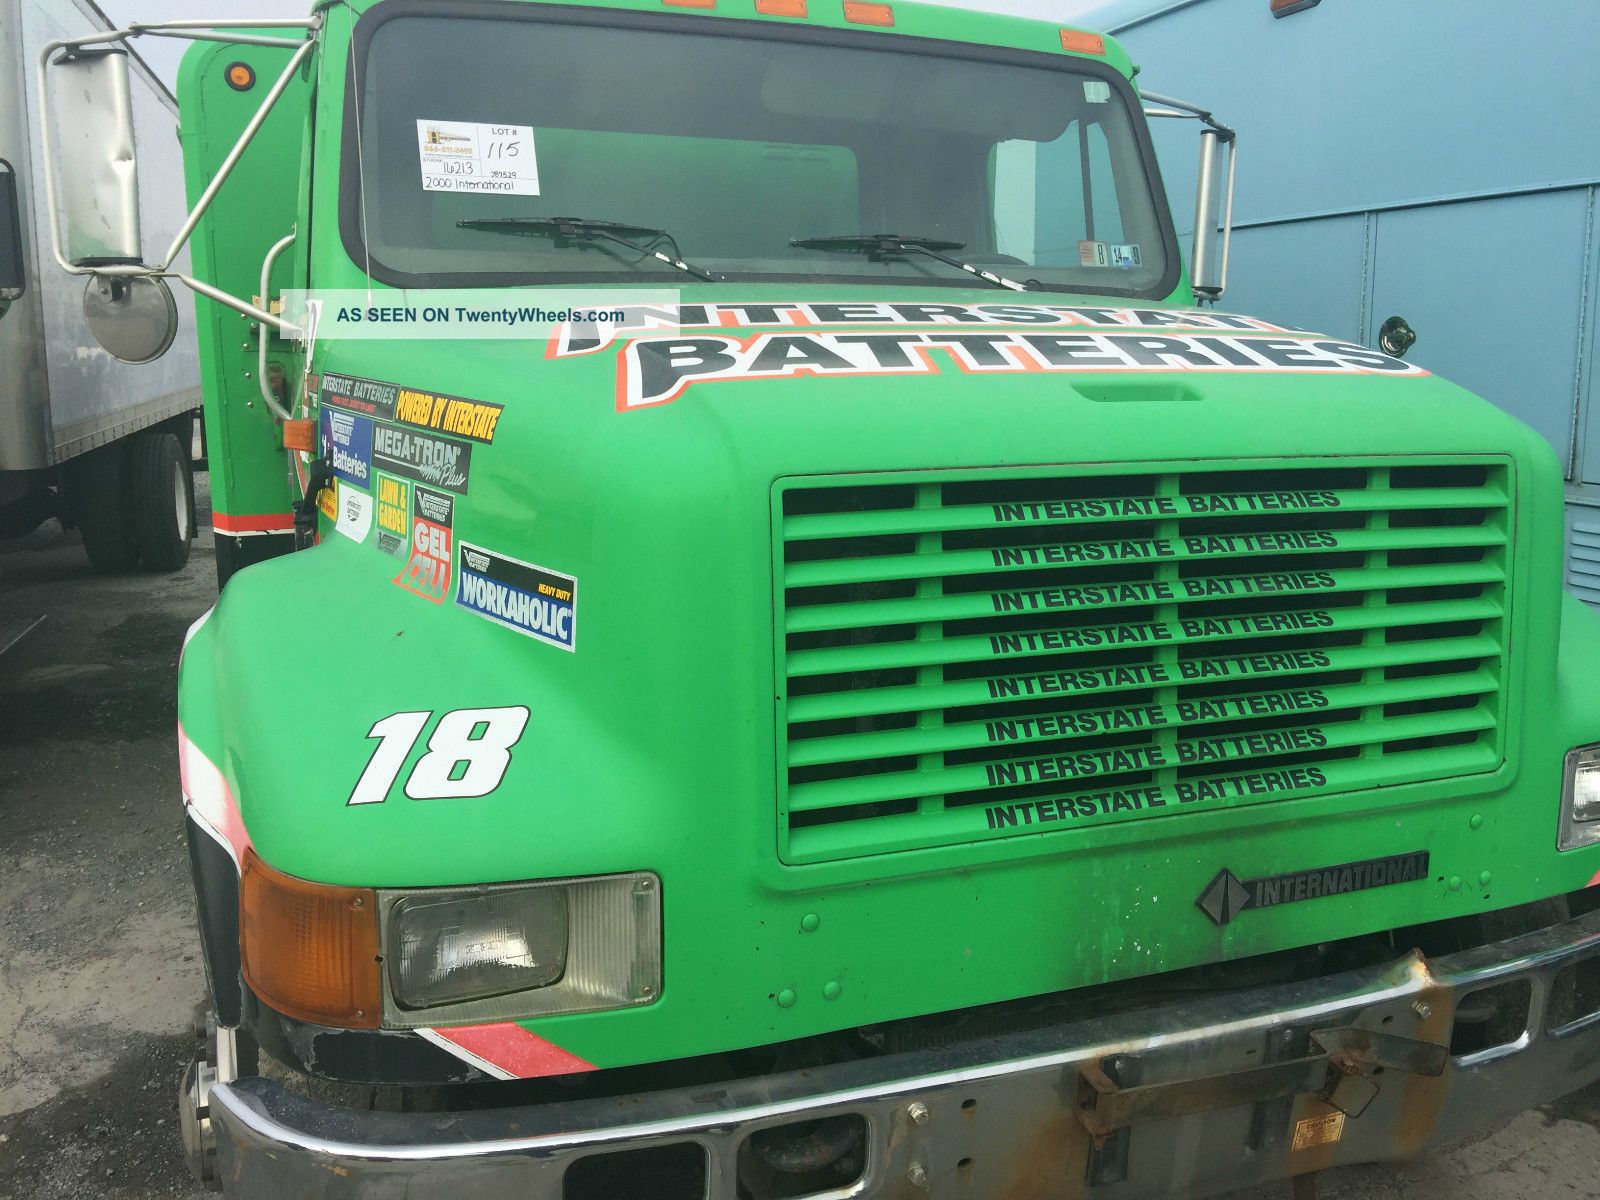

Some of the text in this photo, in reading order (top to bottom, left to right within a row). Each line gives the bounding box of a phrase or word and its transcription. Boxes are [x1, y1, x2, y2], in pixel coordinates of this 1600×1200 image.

[487, 141, 521, 159] 115
[491, 128, 509, 136] LOT
[425, 176, 515, 191] 2000 International
[443, 161, 474, 175] 16213
[625, 328, 1418, 407] BATTERIES
[353, 382, 395, 405] BATTERIES
[396, 390, 433, 426] POWERED
[430, 397, 448, 429] BY
[443, 399, 502, 441] INTERSTATE
[333, 445, 367, 480] Batteries
[438, 463, 466, 486] Plus
[380, 477, 407, 510] LAWN &
[992, 491, 1341, 522] INTERSTATE BATTERIES
[379, 503, 407, 536] GARDEN
[414, 521, 450, 563] GEL
[991, 531, 1338, 567] INTERSTATE BATTERIES
[399, 553, 446, 597] CELL
[538, 582, 571, 602] HEAVY DUTY
[990, 571, 1337, 612] INTERSTATE BATTERIES
[989, 610, 1335, 654] INTERSTATE BATTERIES
[987, 650, 1332, 698] INTERSTATE BATTERIES
[985, 689, 1329, 742] INTERSTATE BATTERIES
[346, 703, 531, 806] 18
[985, 728, 1328, 787] INTERSTATE BATTERIES
[984, 767, 1327, 830] INTERSTATE BATTERIES
[1255, 852, 1428, 907] INTERNATIONAL
